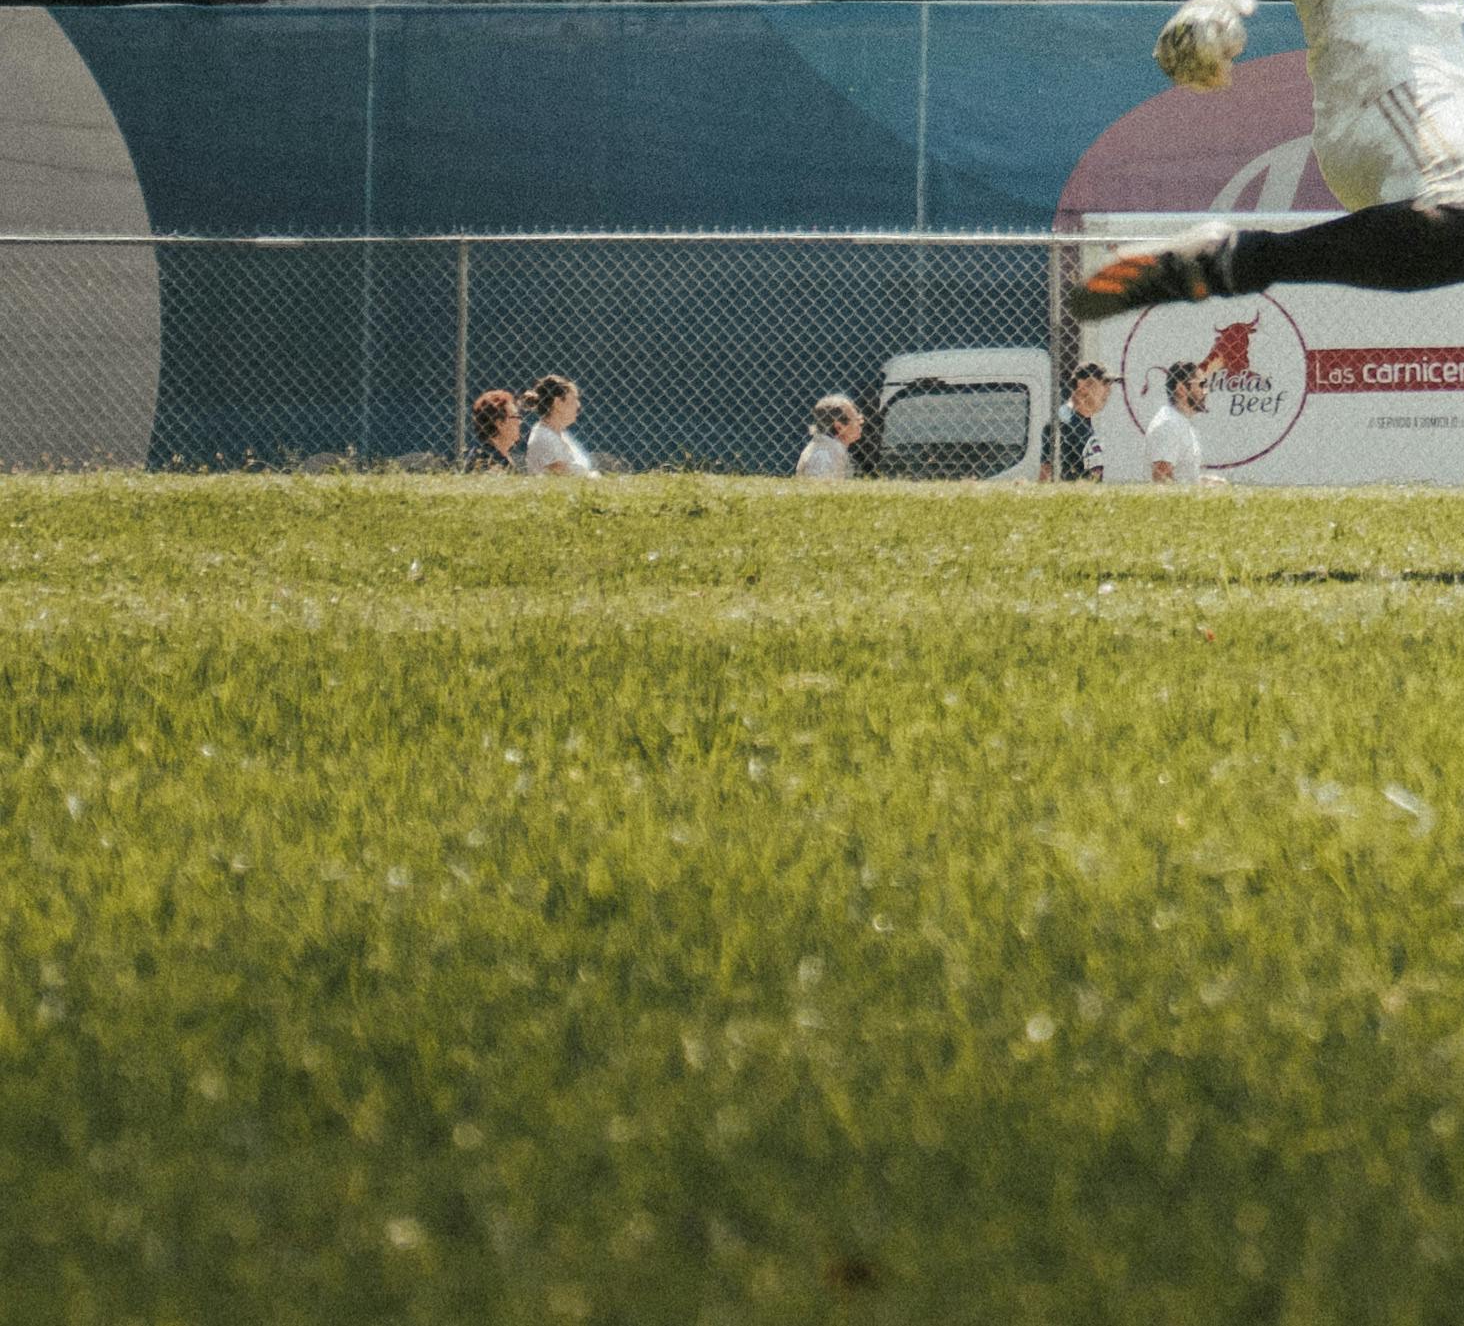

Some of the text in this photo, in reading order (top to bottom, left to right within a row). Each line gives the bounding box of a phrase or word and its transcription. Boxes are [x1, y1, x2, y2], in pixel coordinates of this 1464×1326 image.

[1209, 370, 1272, 392] licias
[1315, 363, 1355, 384] Las
[1229, 390, 1288, 417] Beef
